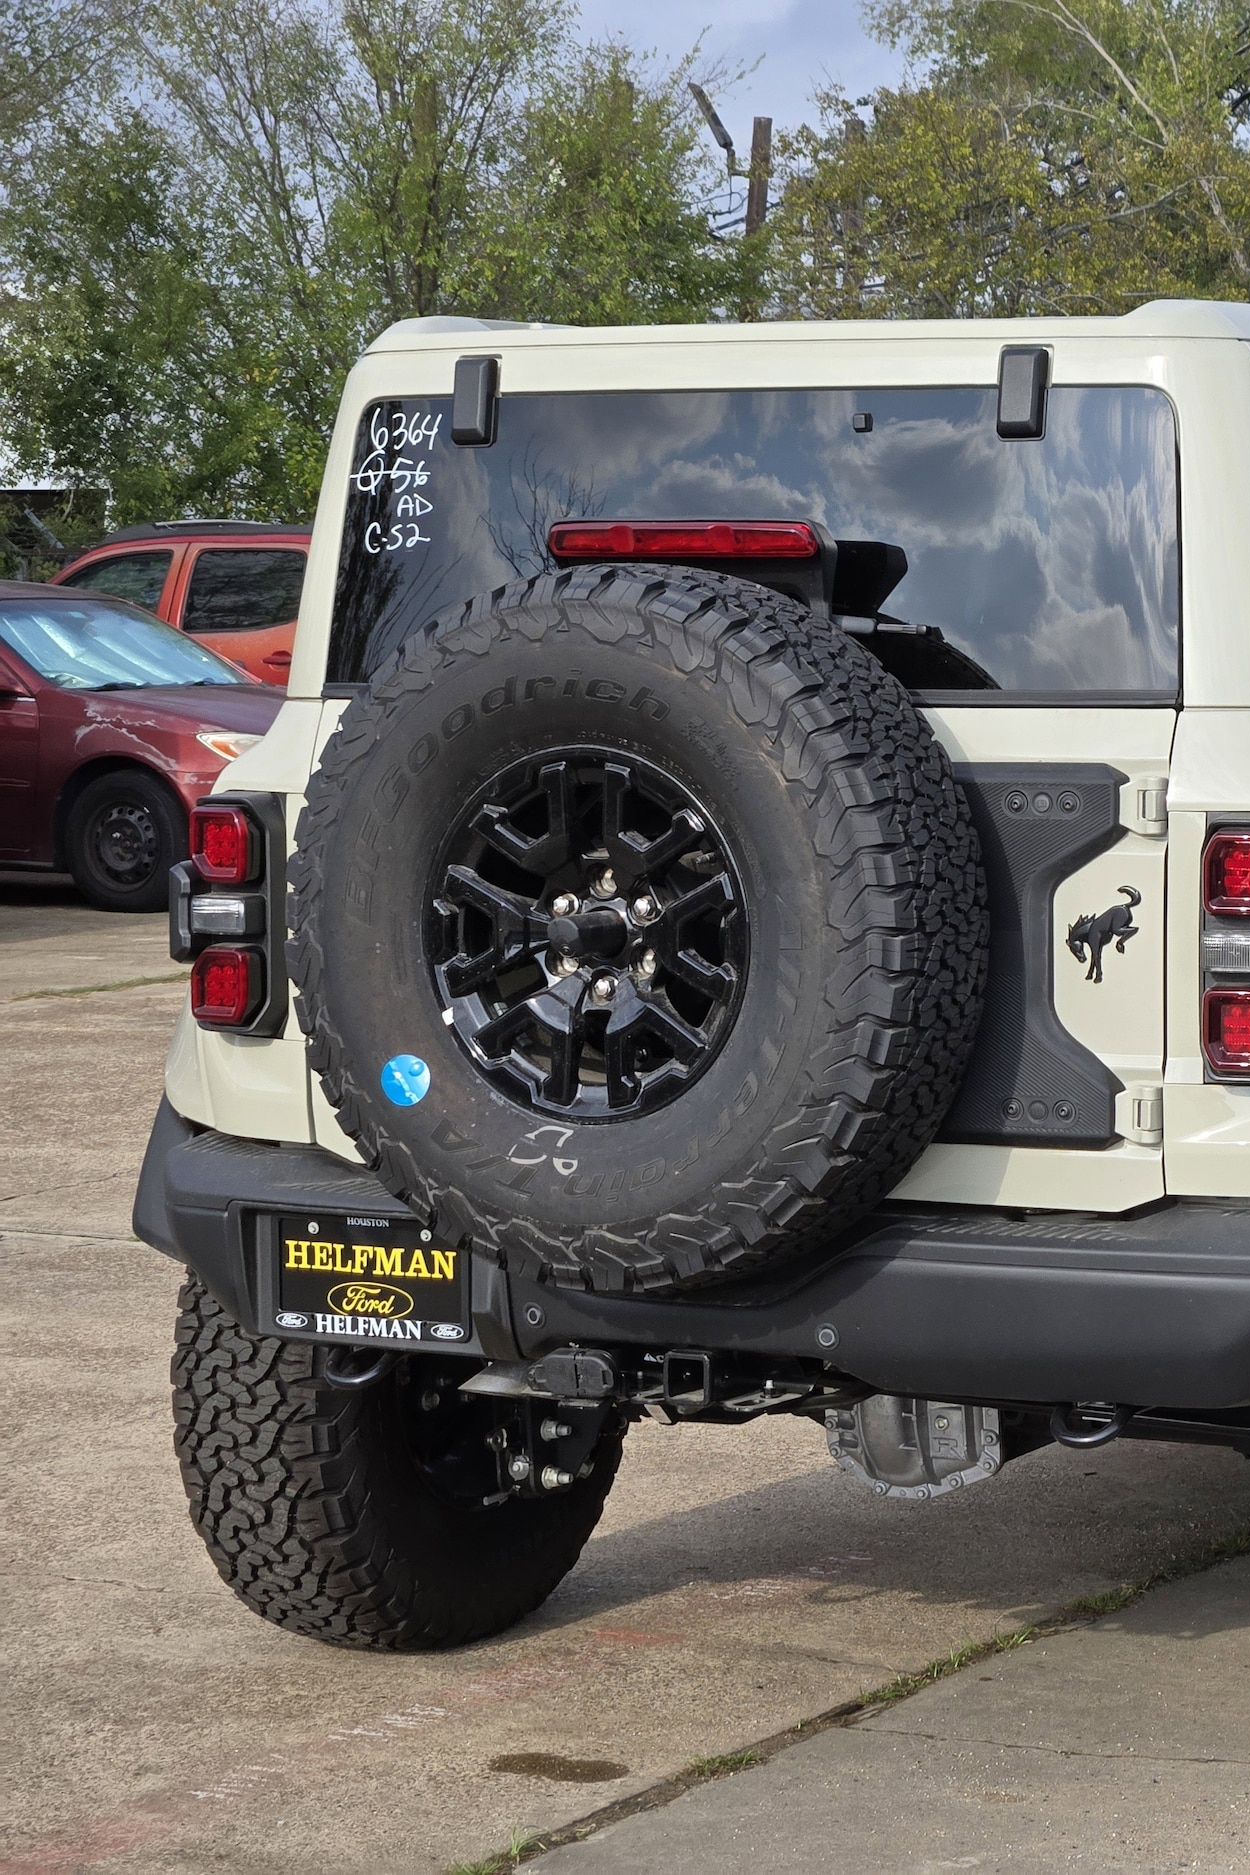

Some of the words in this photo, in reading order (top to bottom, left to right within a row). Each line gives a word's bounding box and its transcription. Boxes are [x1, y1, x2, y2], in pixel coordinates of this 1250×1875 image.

[370, 407, 443, 450] 6364
[396, 493, 434, 518] AD
[346, 1216, 390, 1228] HOUSTON
[284, 1239, 457, 1280] HELFMAN
[341, 1285, 396, 1315] Ford
[280, 1314, 303, 1326] Ford
[314, 1312, 423, 1341] HELFMAN
[436, 1326, 459, 1338] Ford
